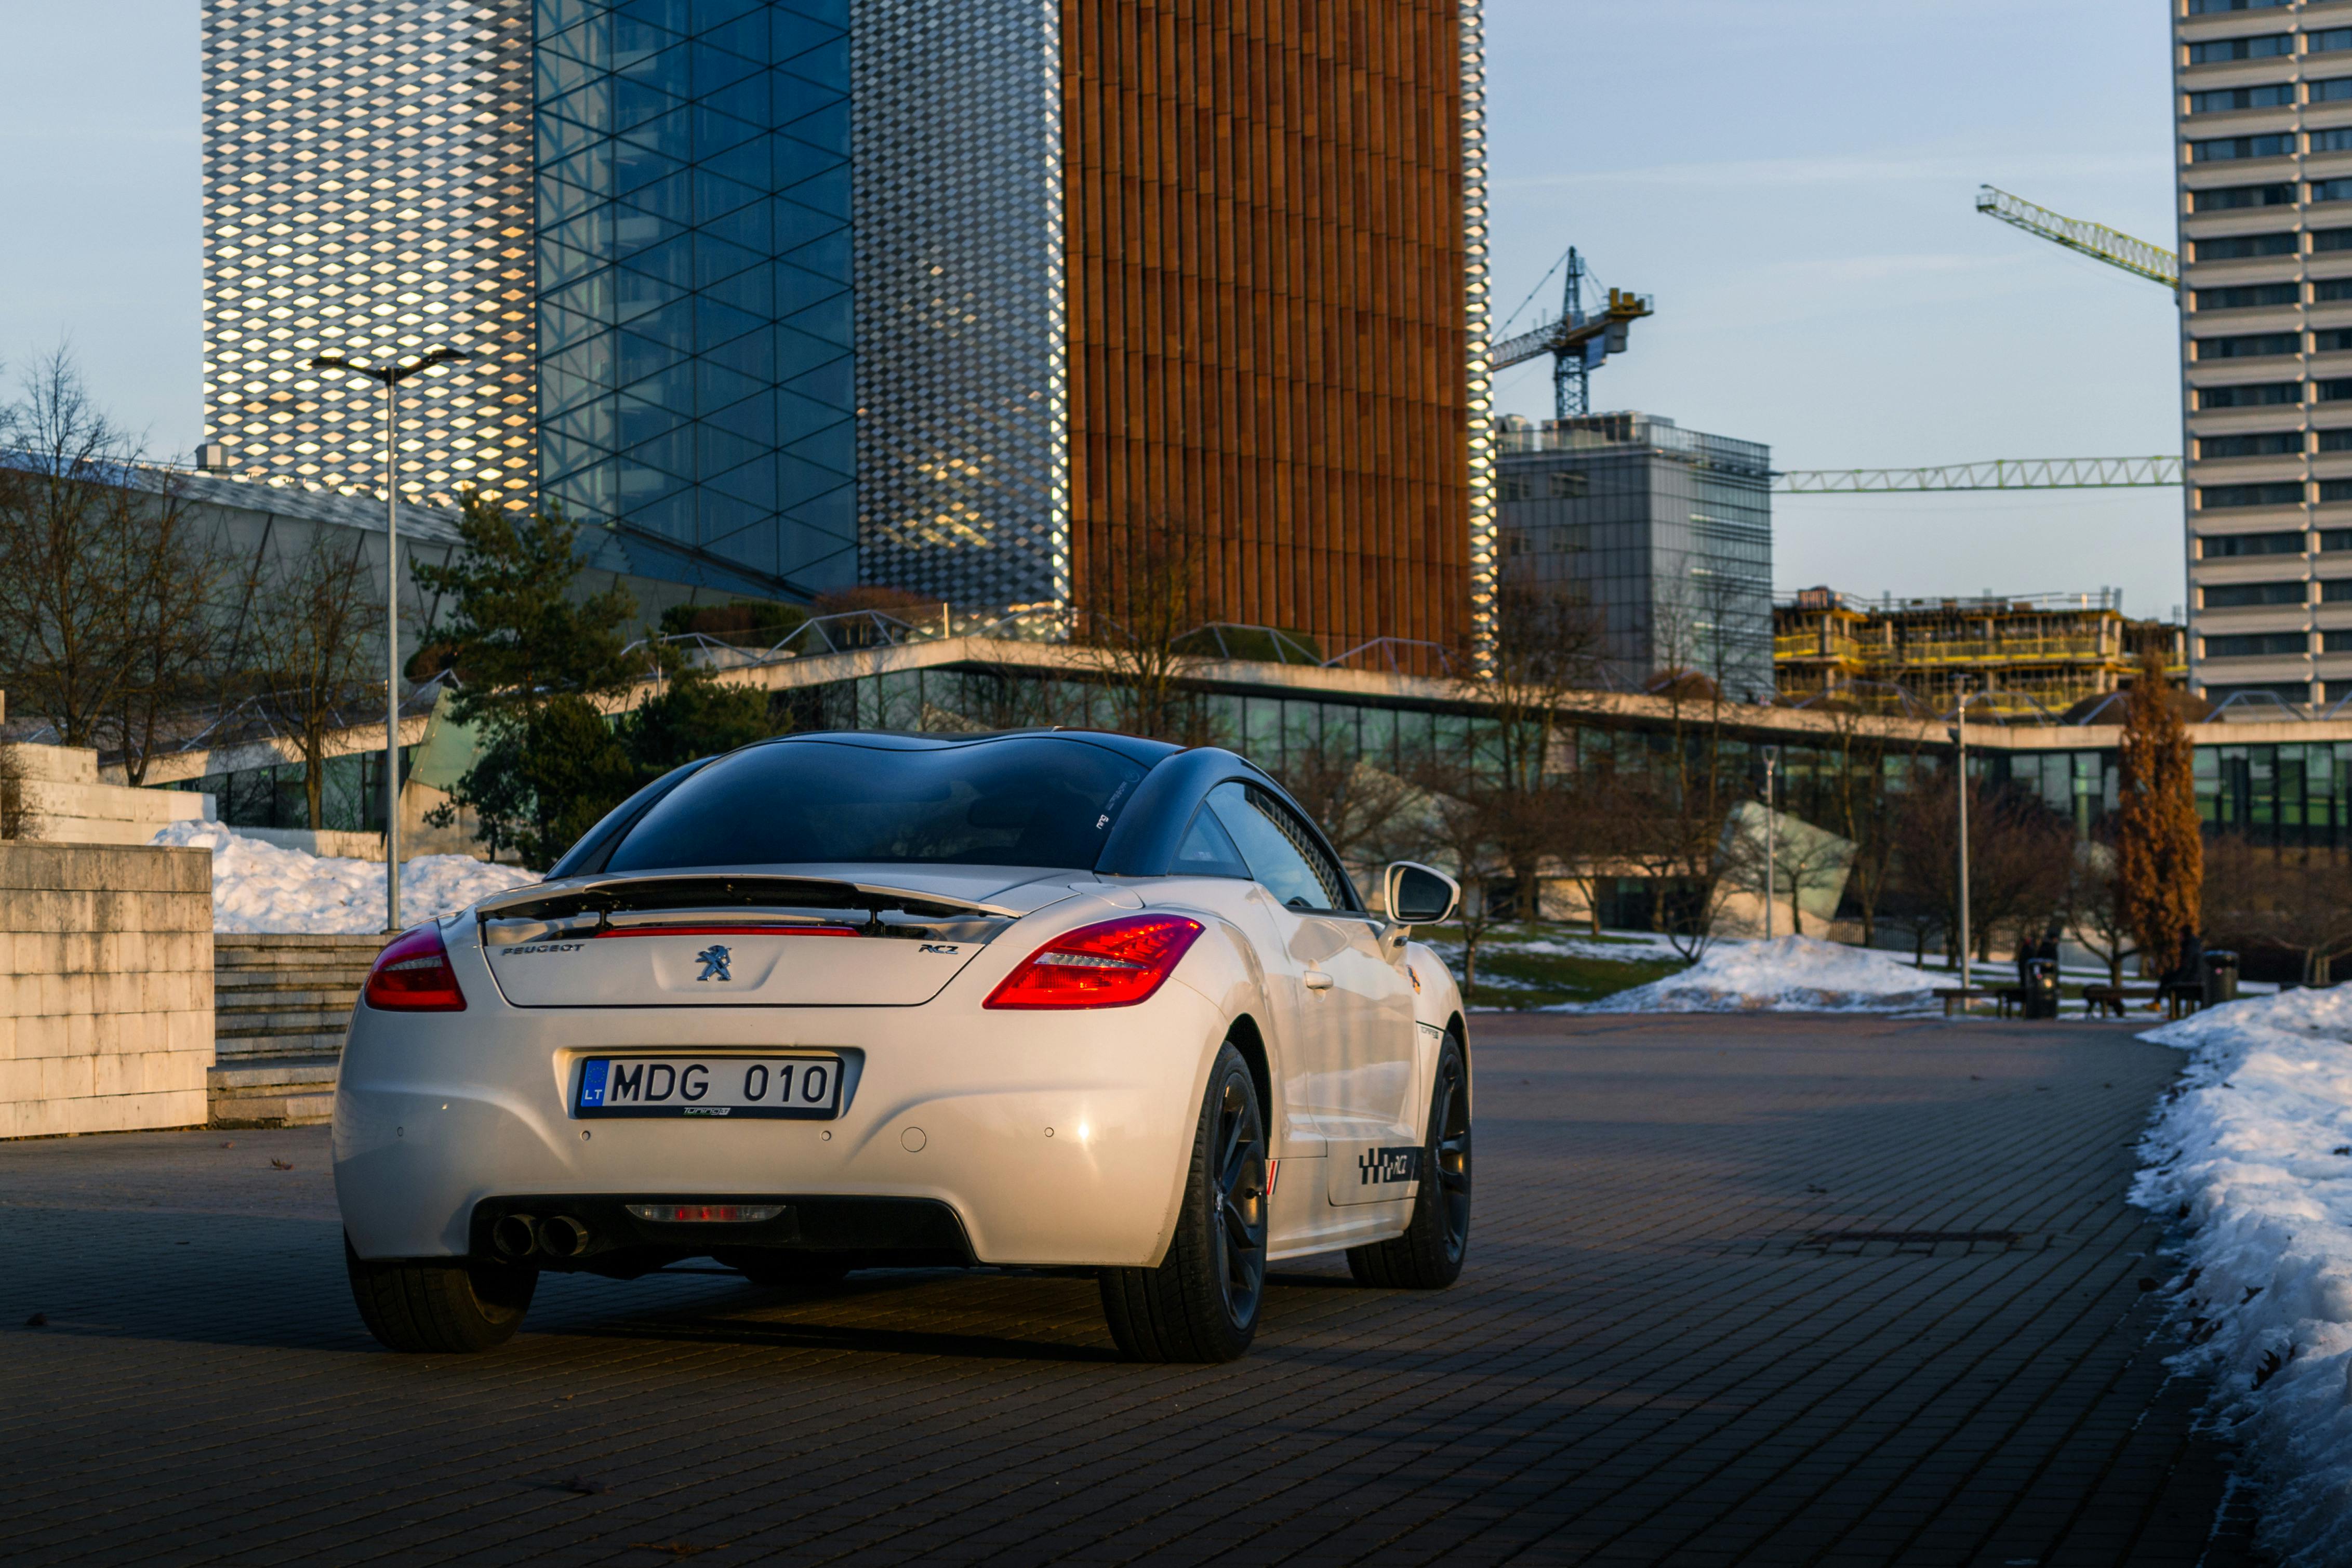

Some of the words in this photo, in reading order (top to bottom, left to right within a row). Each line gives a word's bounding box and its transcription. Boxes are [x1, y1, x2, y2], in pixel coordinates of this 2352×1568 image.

[500, 944, 585, 956] PEUGEOT
[919, 944, 959, 954] RCZ
[611, 1064, 709, 1101] MDG
[744, 1064, 828, 1102] 010
[584, 1089, 603, 1100] LT
